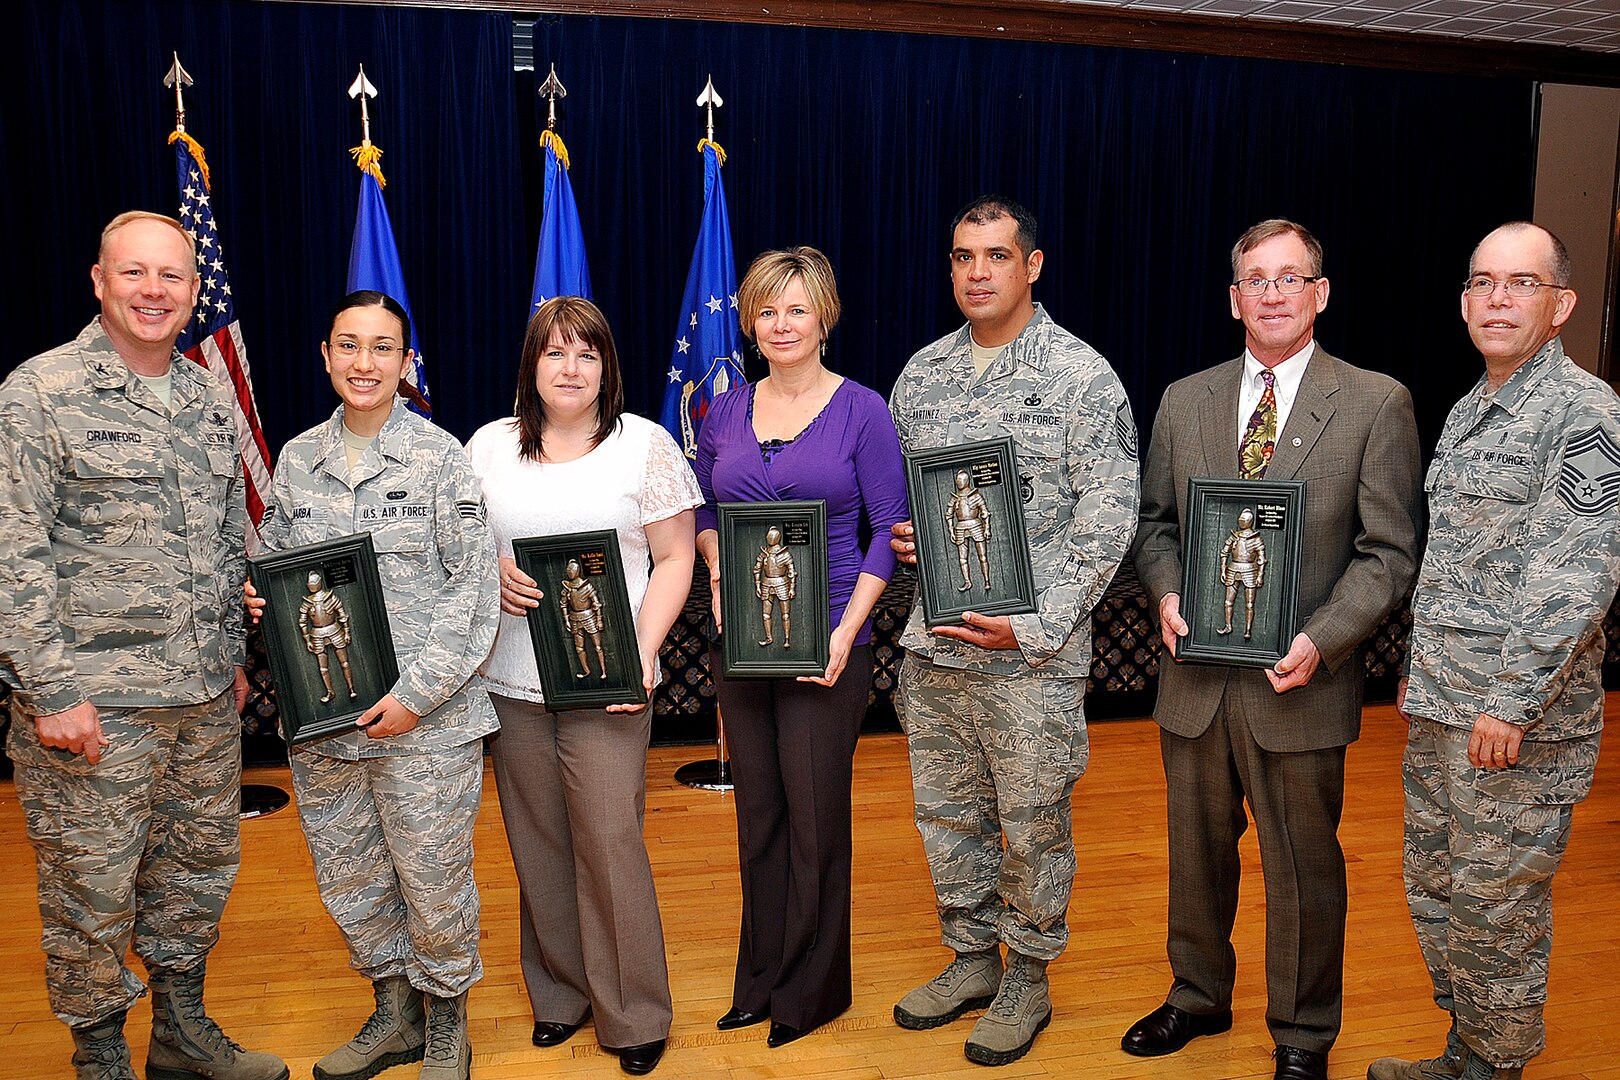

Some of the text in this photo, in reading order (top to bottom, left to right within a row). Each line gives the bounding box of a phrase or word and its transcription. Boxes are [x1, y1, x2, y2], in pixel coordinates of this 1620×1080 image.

[1002, 412, 1060, 426] U.S. AIR FORCE
[86, 430, 141, 443] CRAWFORD
[1484, 451, 1496, 462] AIR
[1497, 453, 1526, 467] FORCE
[363, 506, 428, 519] U.S. AIR FORCE
